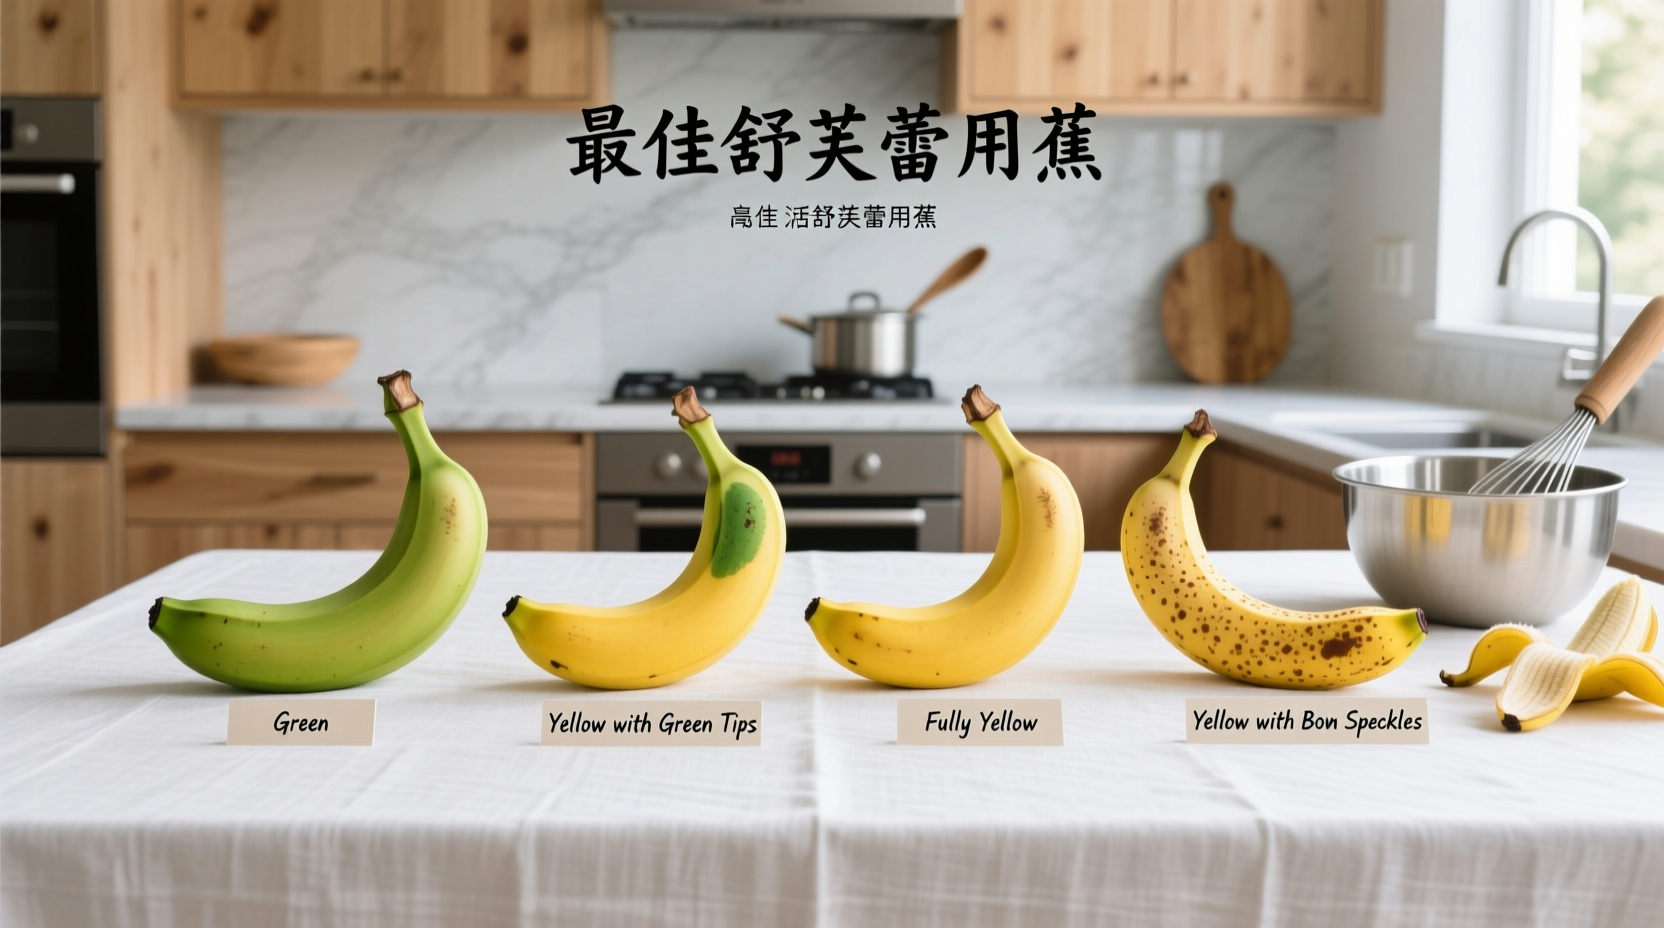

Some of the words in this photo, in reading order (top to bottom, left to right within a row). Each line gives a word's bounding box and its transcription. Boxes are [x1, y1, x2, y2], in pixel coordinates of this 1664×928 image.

[273, 710, 329, 735] Green
[548, 711, 607, 734] Yellow
[613, 711, 652, 734] with
[658, 712, 713, 735] Green
[720, 711, 757, 741] Tips
[925, 709, 972, 739] Fully
[979, 709, 1038, 732] Yellow
[1193, 708, 1250, 731] Yellow
[1256, 709, 1294, 730] with
[1301, 710, 1338, 730] Bon
[1344, 708, 1423, 739] Speckles
